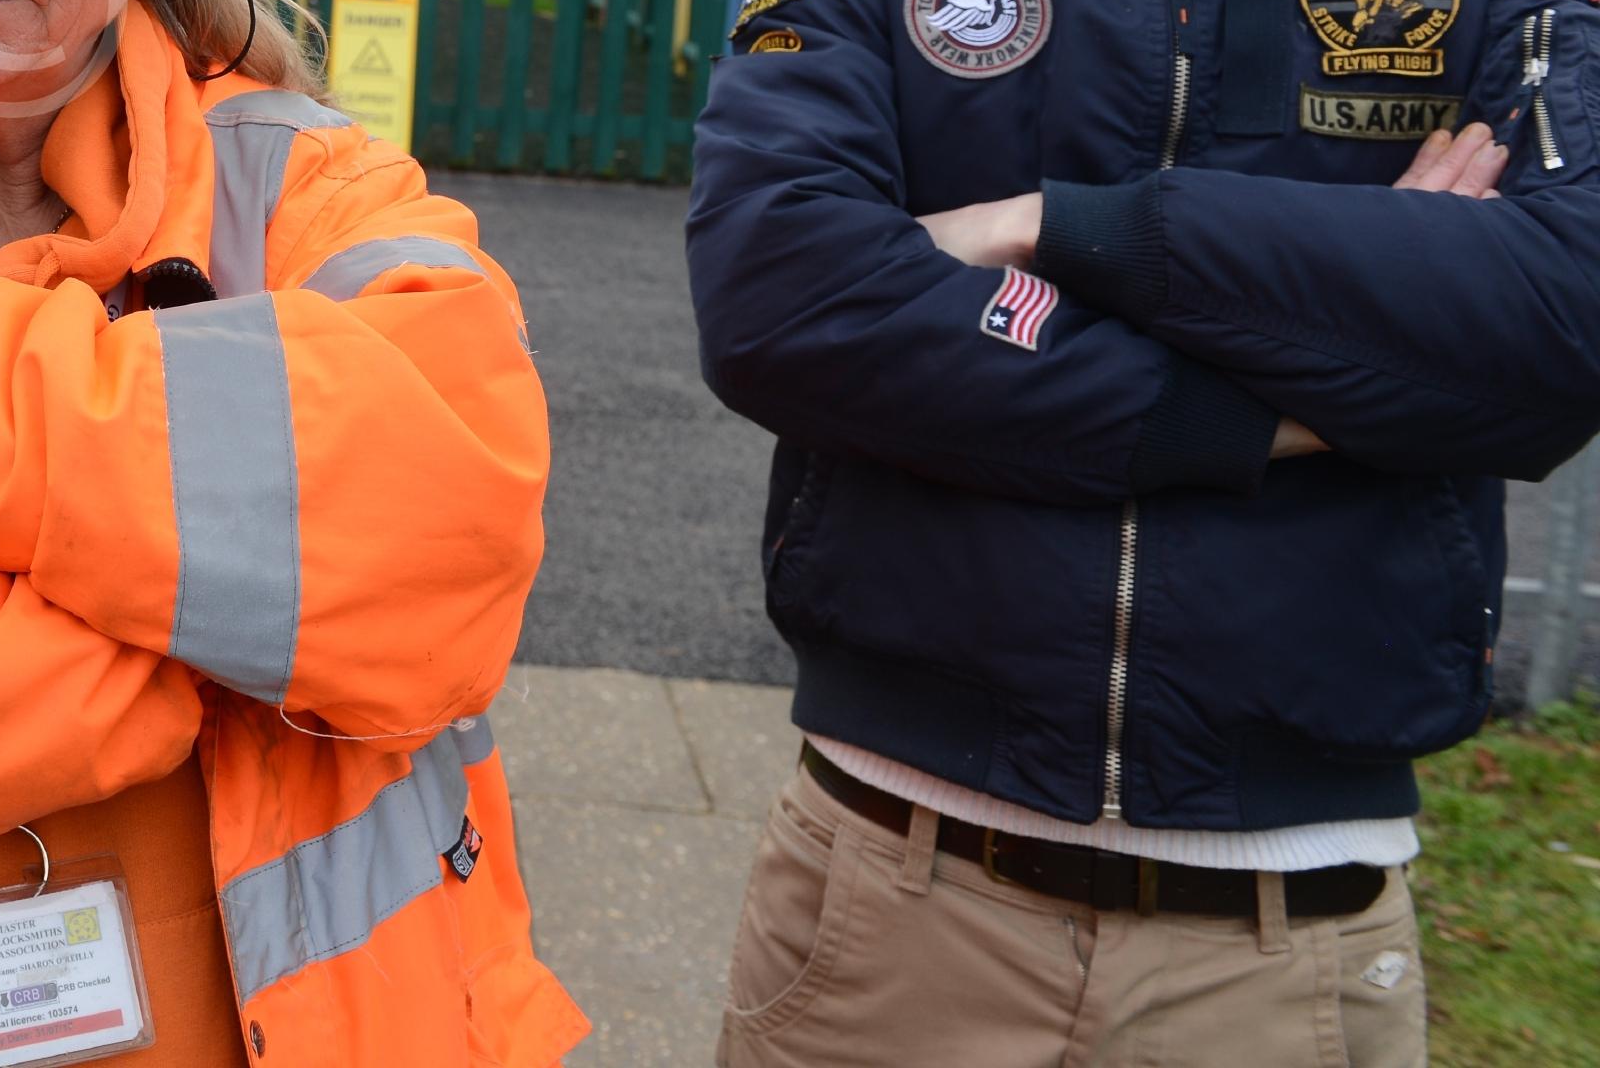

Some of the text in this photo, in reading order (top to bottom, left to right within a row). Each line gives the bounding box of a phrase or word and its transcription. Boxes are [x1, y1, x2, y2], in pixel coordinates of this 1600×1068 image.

[1313, 6, 1448, 47] STRIKE FORCE
[930, 34, 969, 66] WEAR
[975, 42, 1020, 67] WORK
[1334, 53, 1432, 70] FLYING HIGH
[20, 958, 54, 972] SHARON
[58, 975, 111, 993] CRB Checked
[14, 988, 40, 1004] CRB
[11, 1013, 46, 1027] licence:
[48, 1005, 79, 1019] 103574
